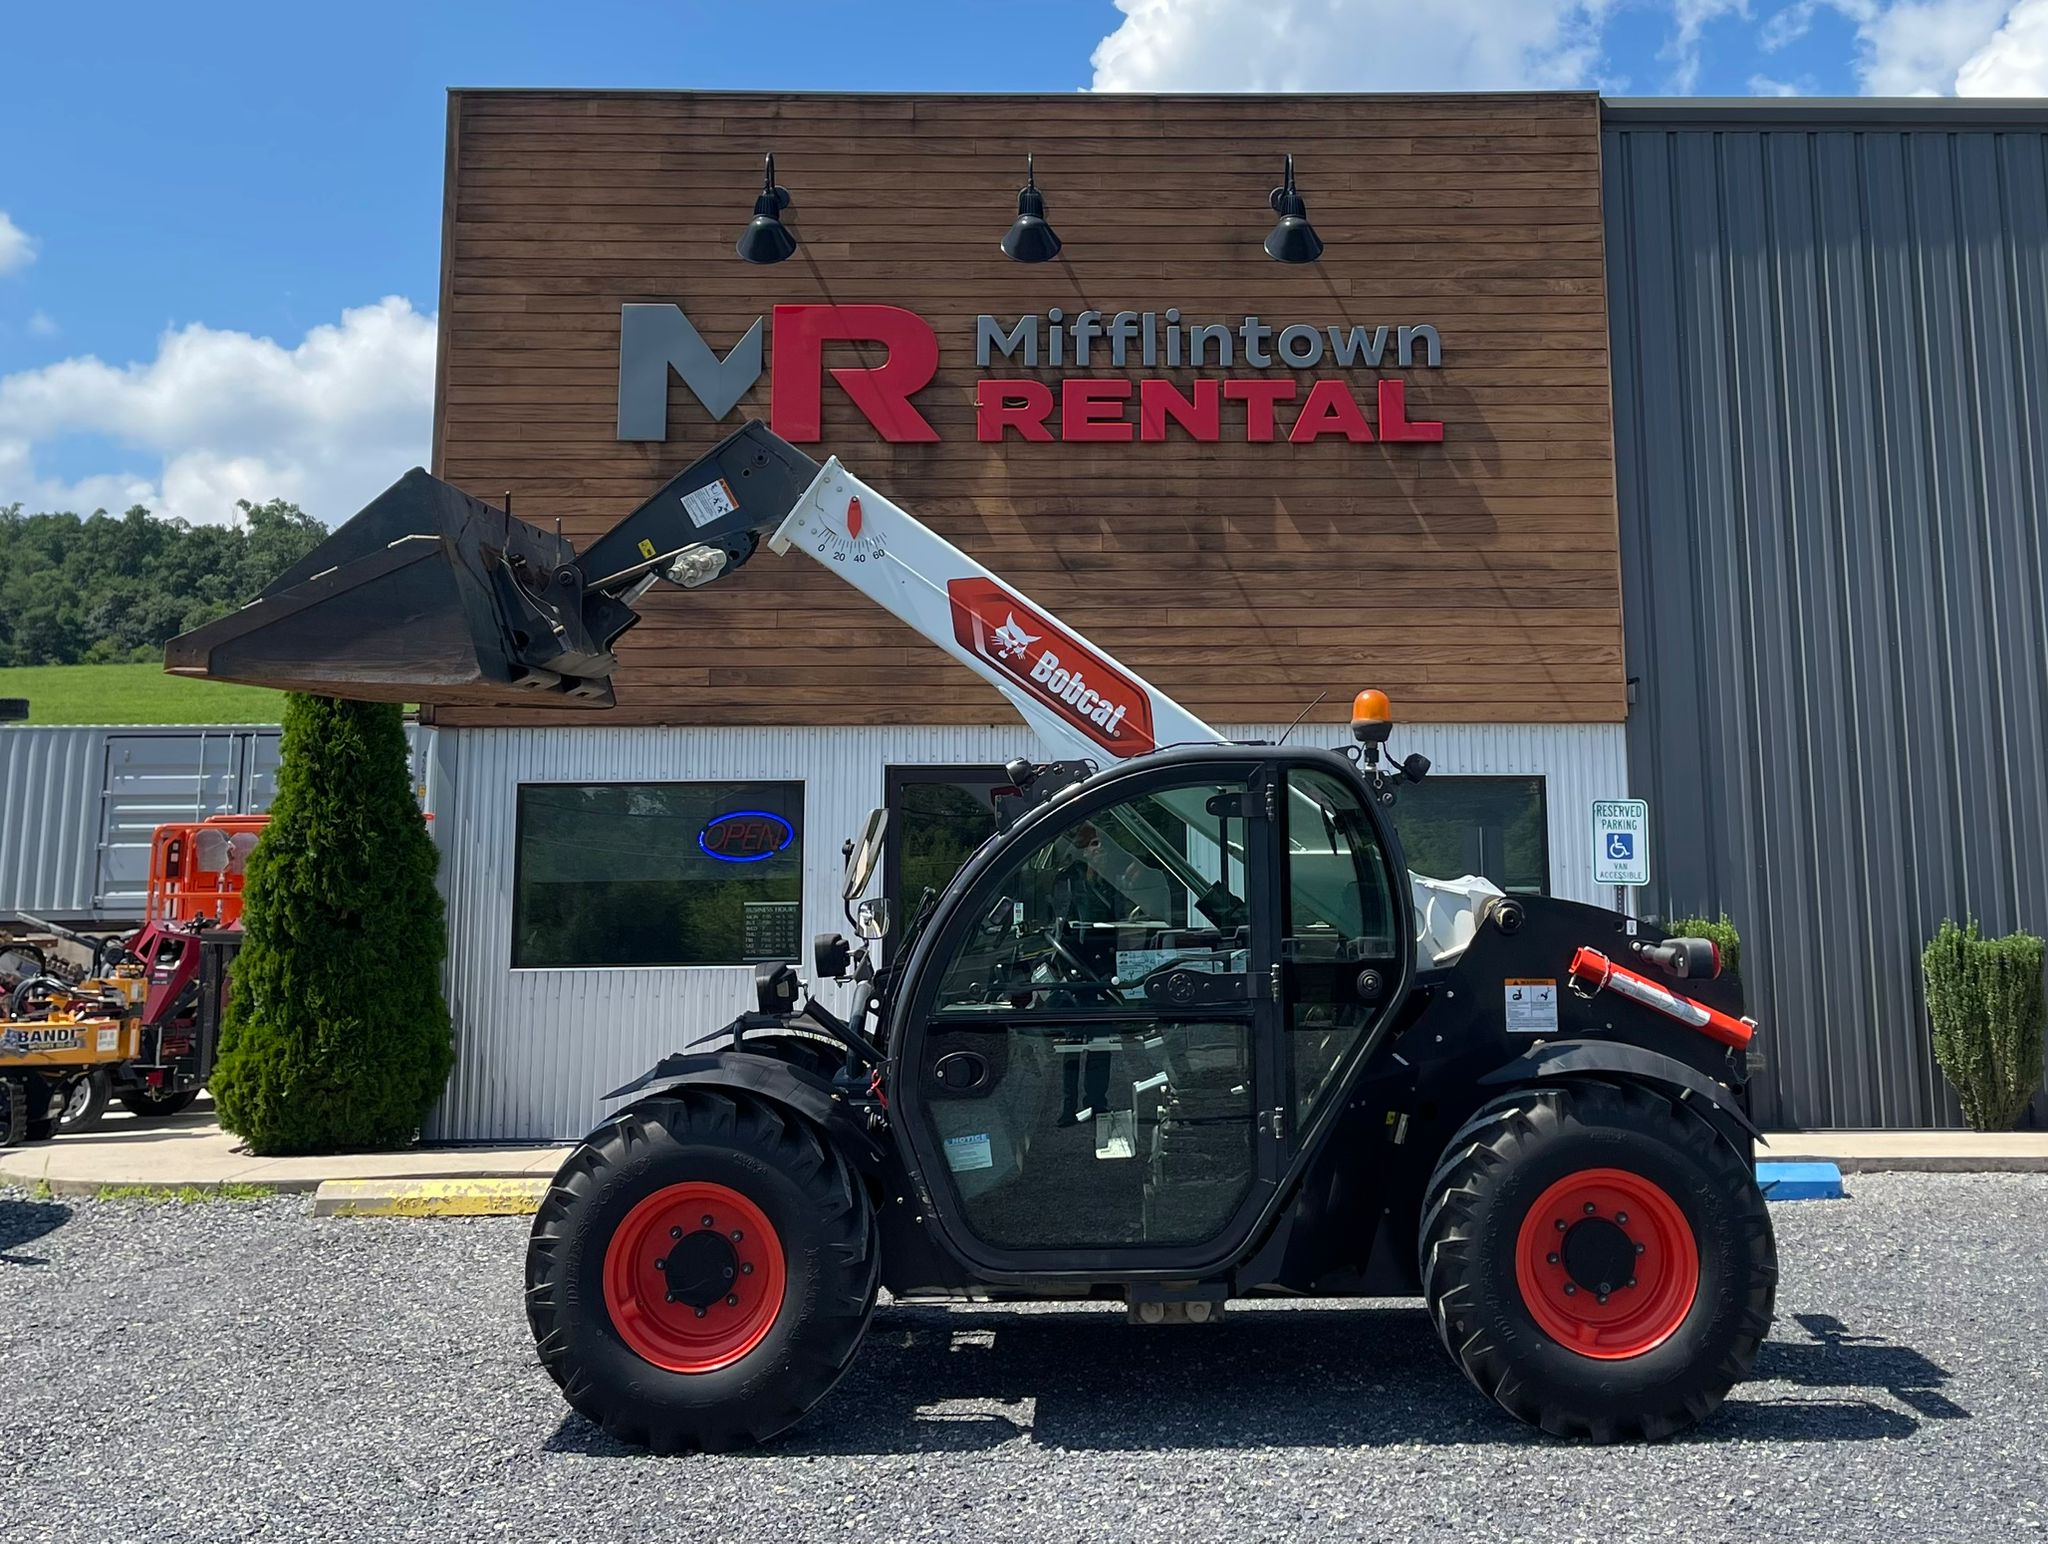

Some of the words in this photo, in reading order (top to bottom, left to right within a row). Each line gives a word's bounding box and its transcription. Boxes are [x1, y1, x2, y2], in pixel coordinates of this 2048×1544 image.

[975, 307, 1444, 369] Mifflintown
[618, 303, 940, 442] MR
[977, 379, 1444, 443] RENTAL
[817, 544, 826, 553] 0
[833, 551, 846, 563] 20
[853, 553, 867, 564] 40
[872, 548, 886, 560] 60
[1029, 650, 1127, 733] Bobcat
[1597, 805, 1642, 817] RESERVED
[1602, 819, 1637, 830] PARKING
[704, 822, 784, 851] OPEN
[951, 1133, 988, 1145] NOTICE
